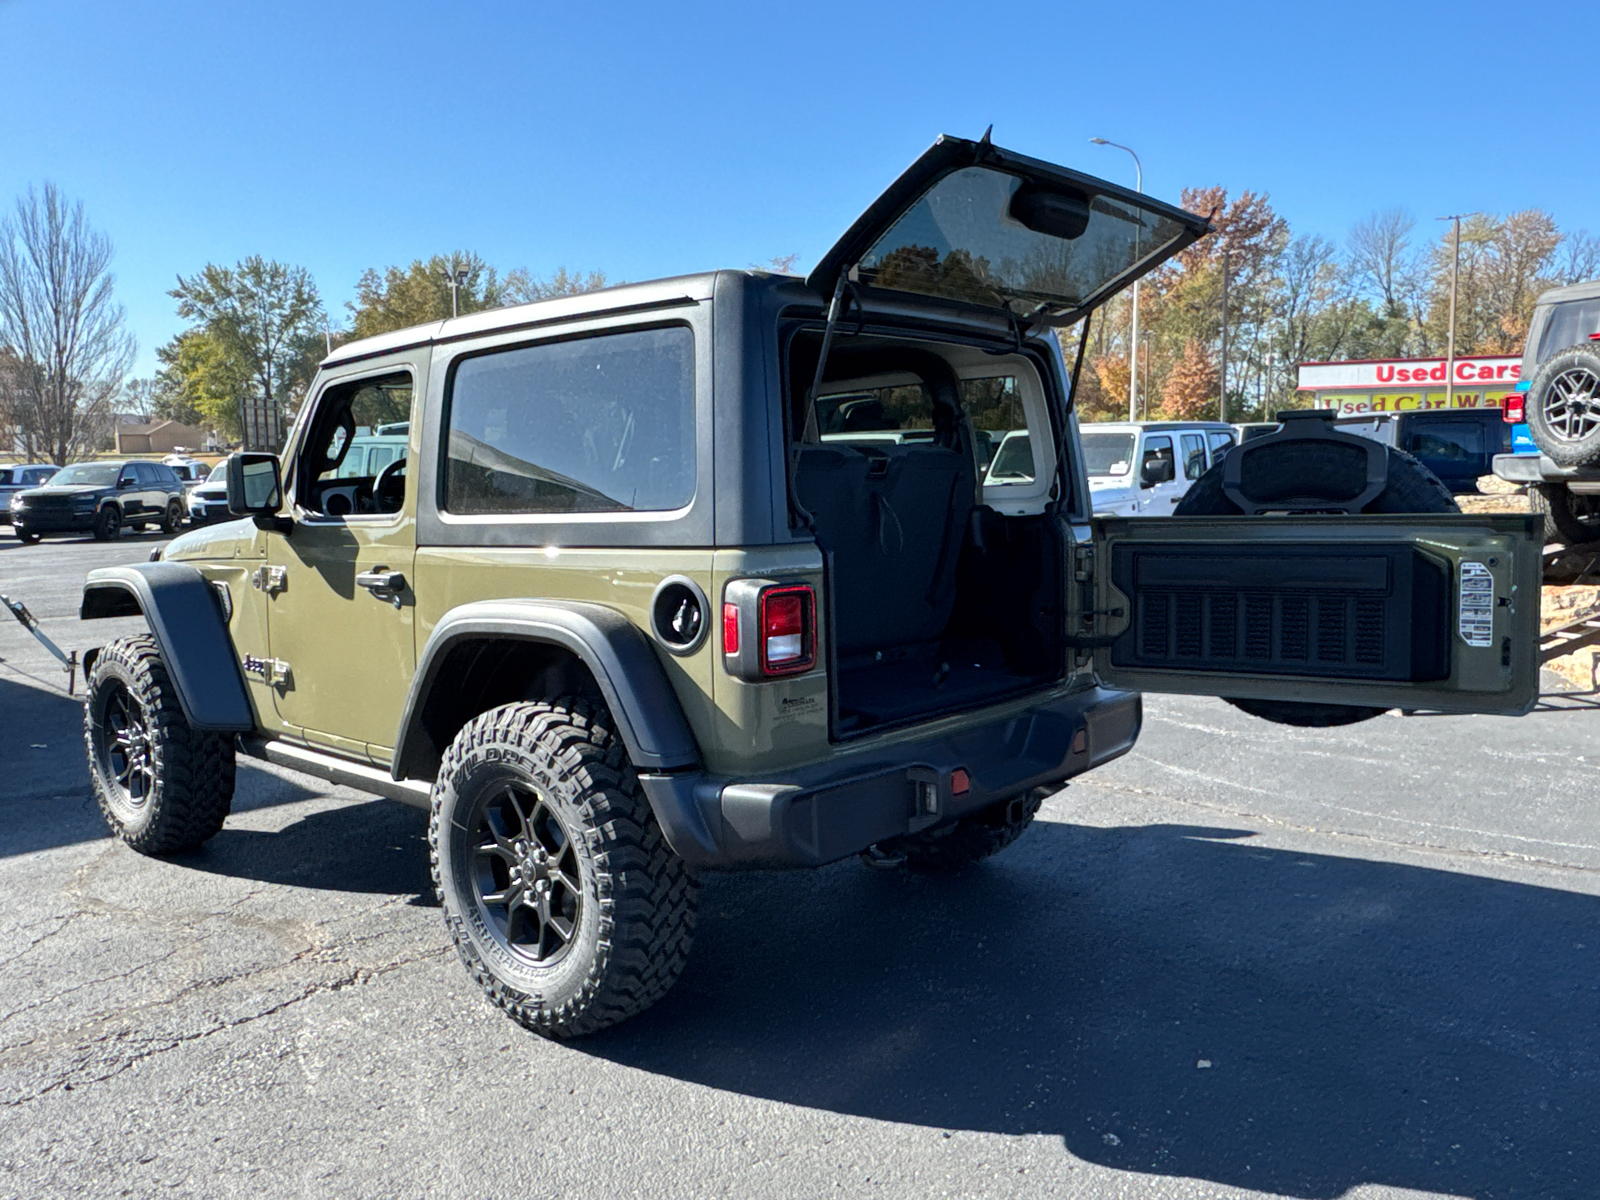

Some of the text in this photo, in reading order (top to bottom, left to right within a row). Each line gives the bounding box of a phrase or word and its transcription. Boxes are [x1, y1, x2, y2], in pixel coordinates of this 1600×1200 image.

[1376, 362, 1521, 382] Used Cars
[1324, 397, 1385, 414] Used
[1394, 396, 1446, 411] Car
[452, 747, 571, 808] WILDPEAK
